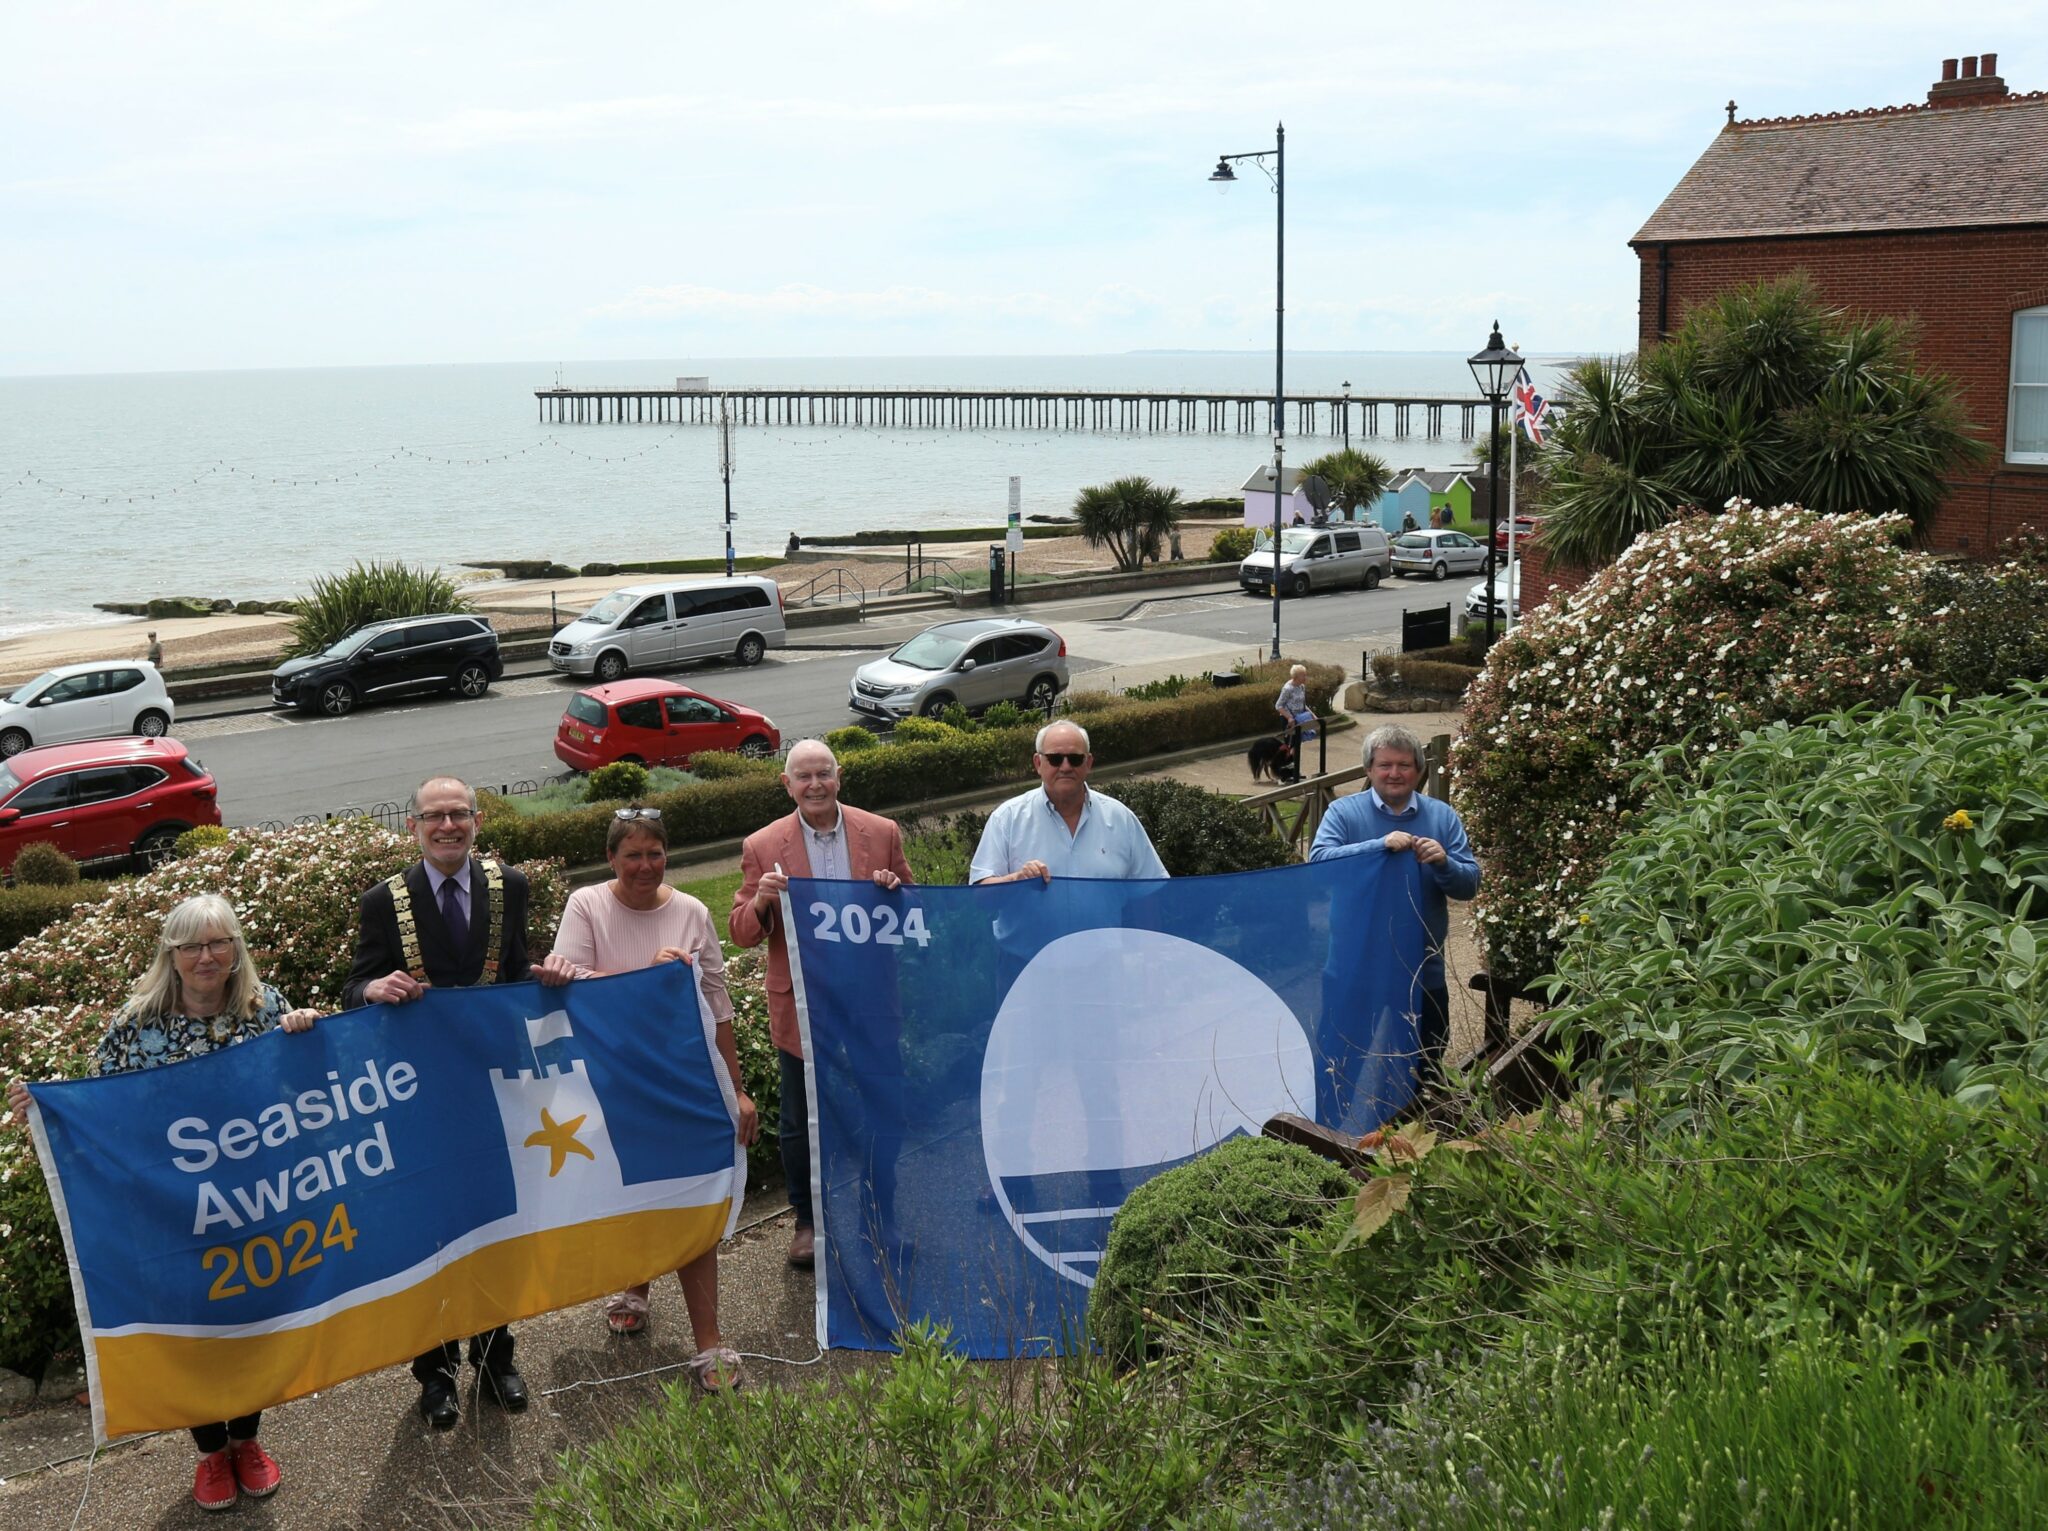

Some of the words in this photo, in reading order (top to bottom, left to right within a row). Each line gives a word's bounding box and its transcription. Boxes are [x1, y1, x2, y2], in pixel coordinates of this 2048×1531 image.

[809, 901, 932, 947] 2024
[166, 1058, 418, 1173] Seaside
[192, 1121, 395, 1235] Award
[202, 1202, 358, 1301] 2024
